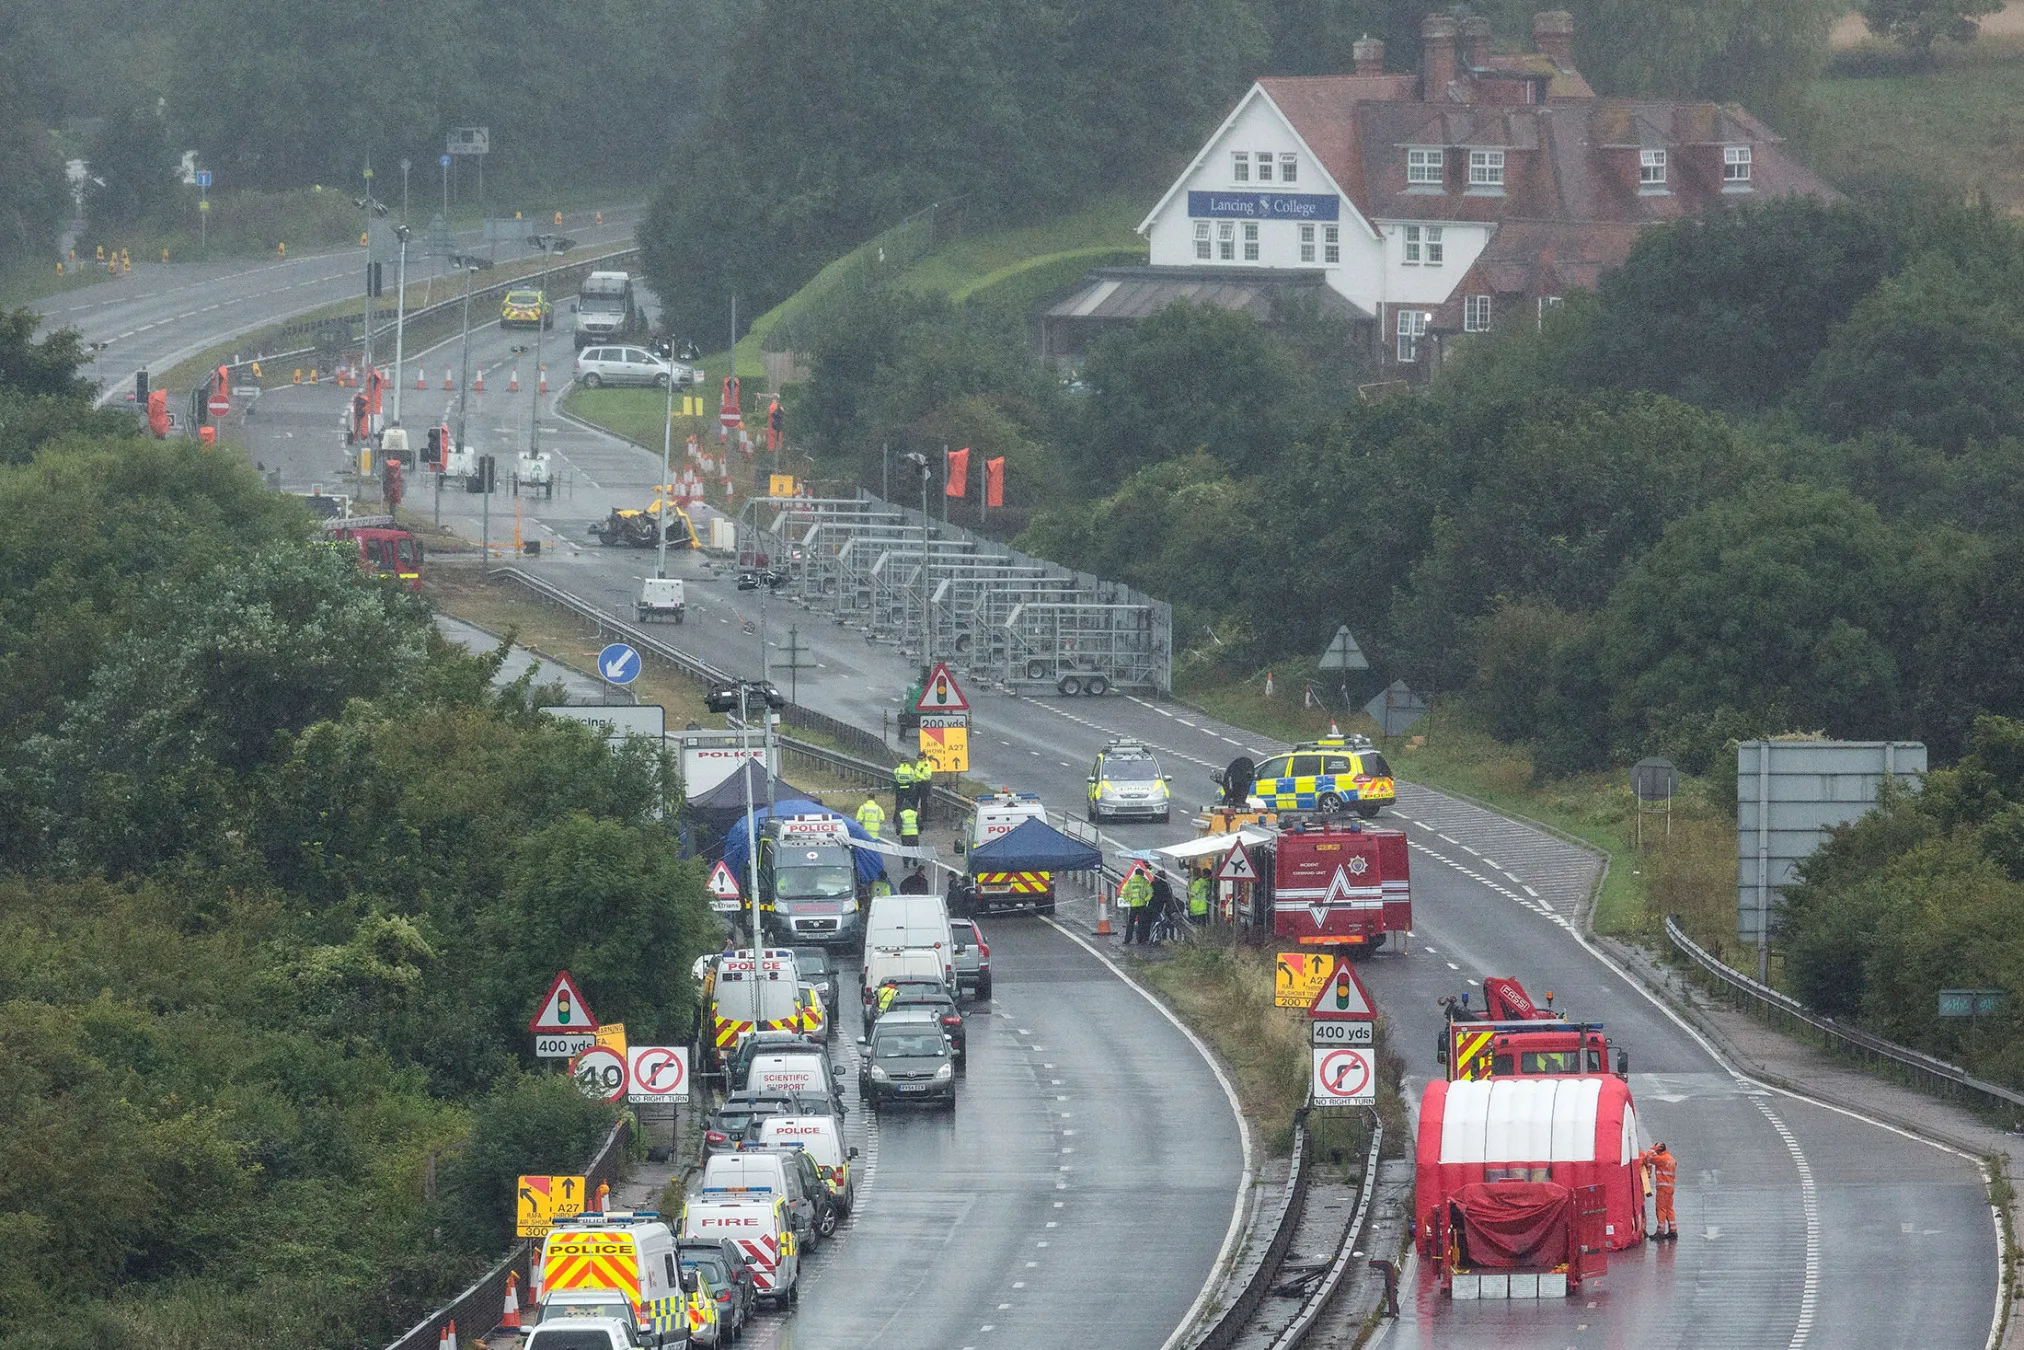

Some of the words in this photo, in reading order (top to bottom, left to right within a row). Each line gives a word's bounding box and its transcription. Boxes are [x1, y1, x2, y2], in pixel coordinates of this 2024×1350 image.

[1210, 198, 1254, 215] Lancing
[1274, 199, 1316, 216] College
[922, 719, 944, 728] 200
[789, 824, 839, 833] POLICE
[728, 962, 780, 971] POLCE
[1502, 985, 1529, 1010] FASSI
[1316, 1026, 1344, 1038] 400
[1348, 1027, 1370, 1041] yds
[538, 1040, 567, 1053] 400
[582, 1065, 622, 1089] 40
[558, 1203, 580, 1213] A27
[702, 1218, 759, 1227] FIRE
[525, 1227, 549, 1236] 300
[550, 1245, 632, 1254] POLICE
